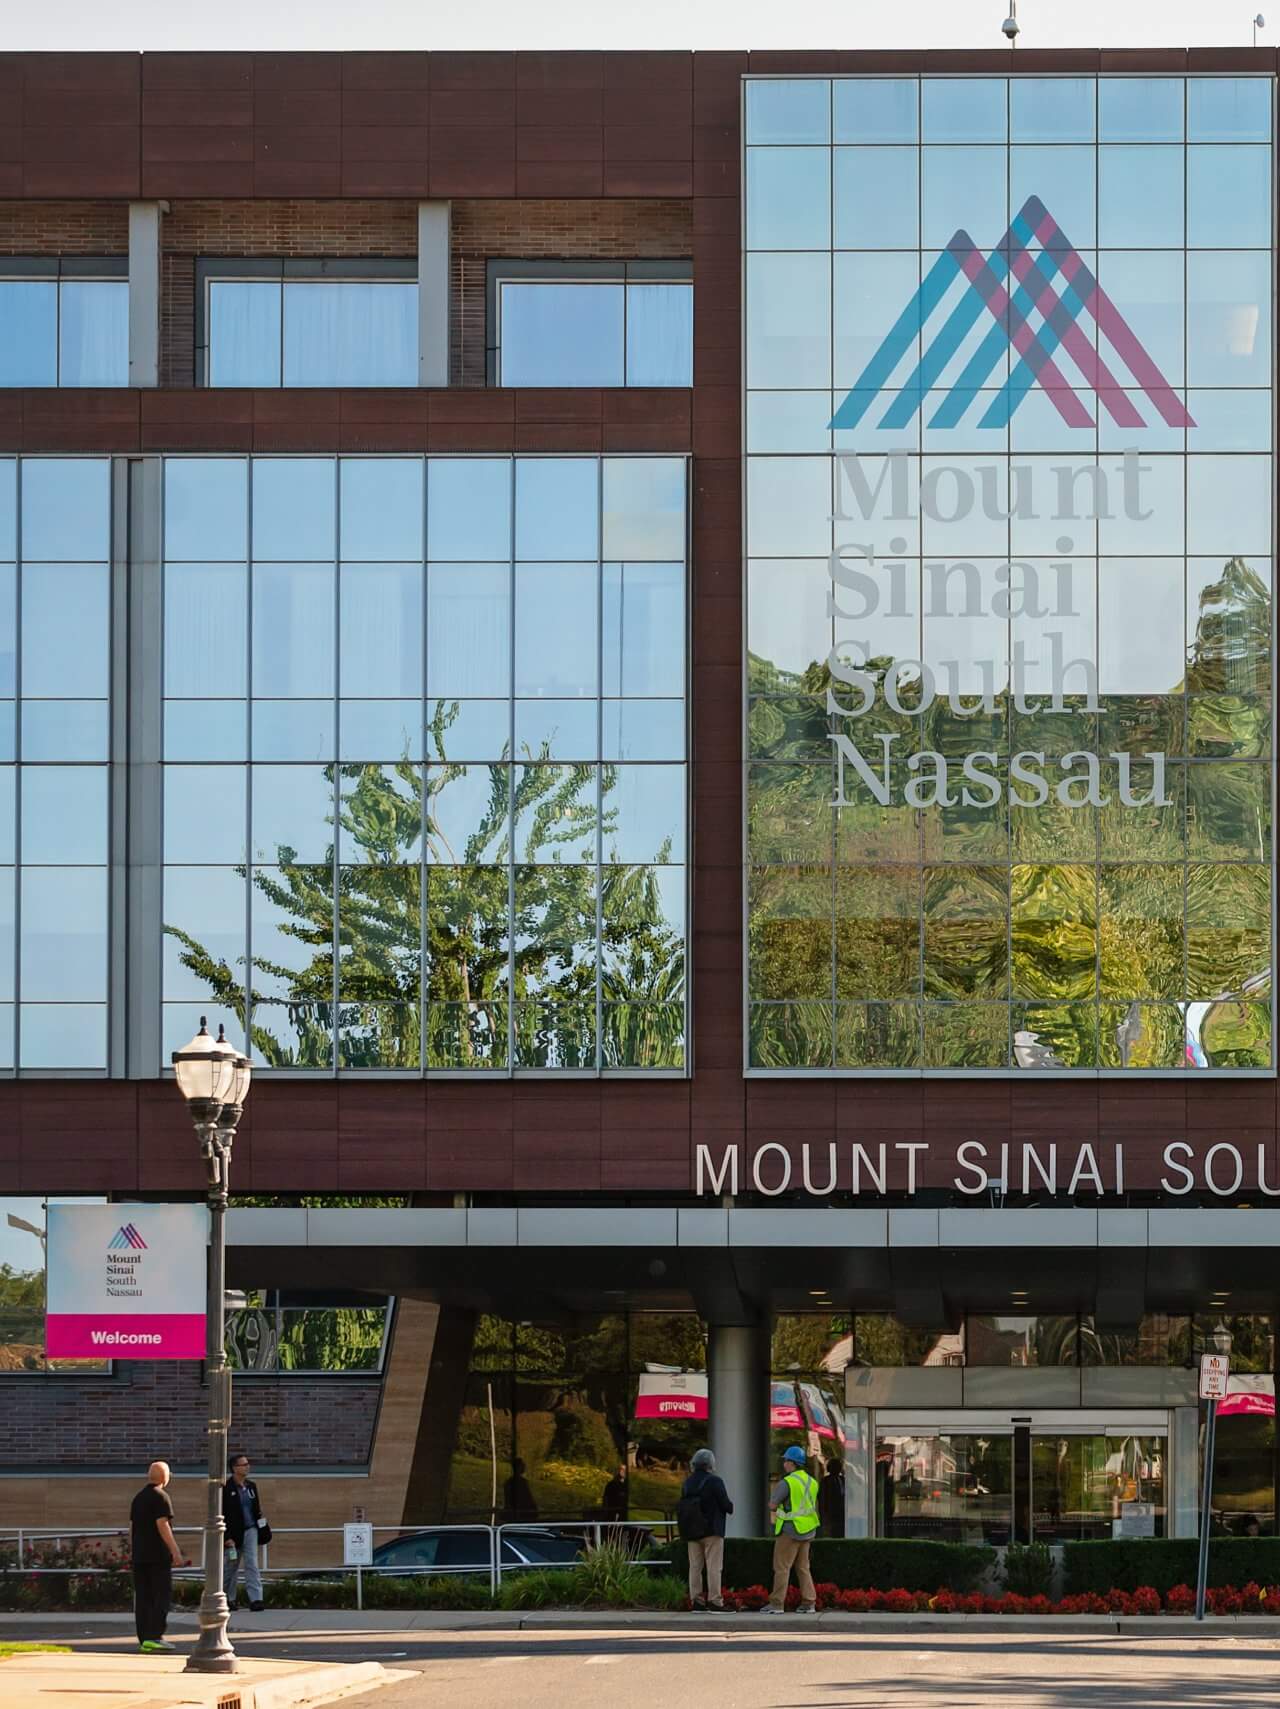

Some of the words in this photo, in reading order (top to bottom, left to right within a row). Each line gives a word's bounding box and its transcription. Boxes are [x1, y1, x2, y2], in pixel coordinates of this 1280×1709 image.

[826, 446, 1154, 522] Mount
[826, 536, 1080, 619] Sinai
[826, 632, 1107, 718] South
[828, 733, 1174, 809] Nassau
[696, 1142, 929, 1196] MOUNT
[953, 1140, 1123, 1195] SINAI
[106, 1254, 142, 1264] Mount
[106, 1264, 135, 1275] Sinai
[105, 1287, 143, 1297] Nassau
[106, 1275, 137, 1286] South
[91, 1331, 162, 1345] Welcome
